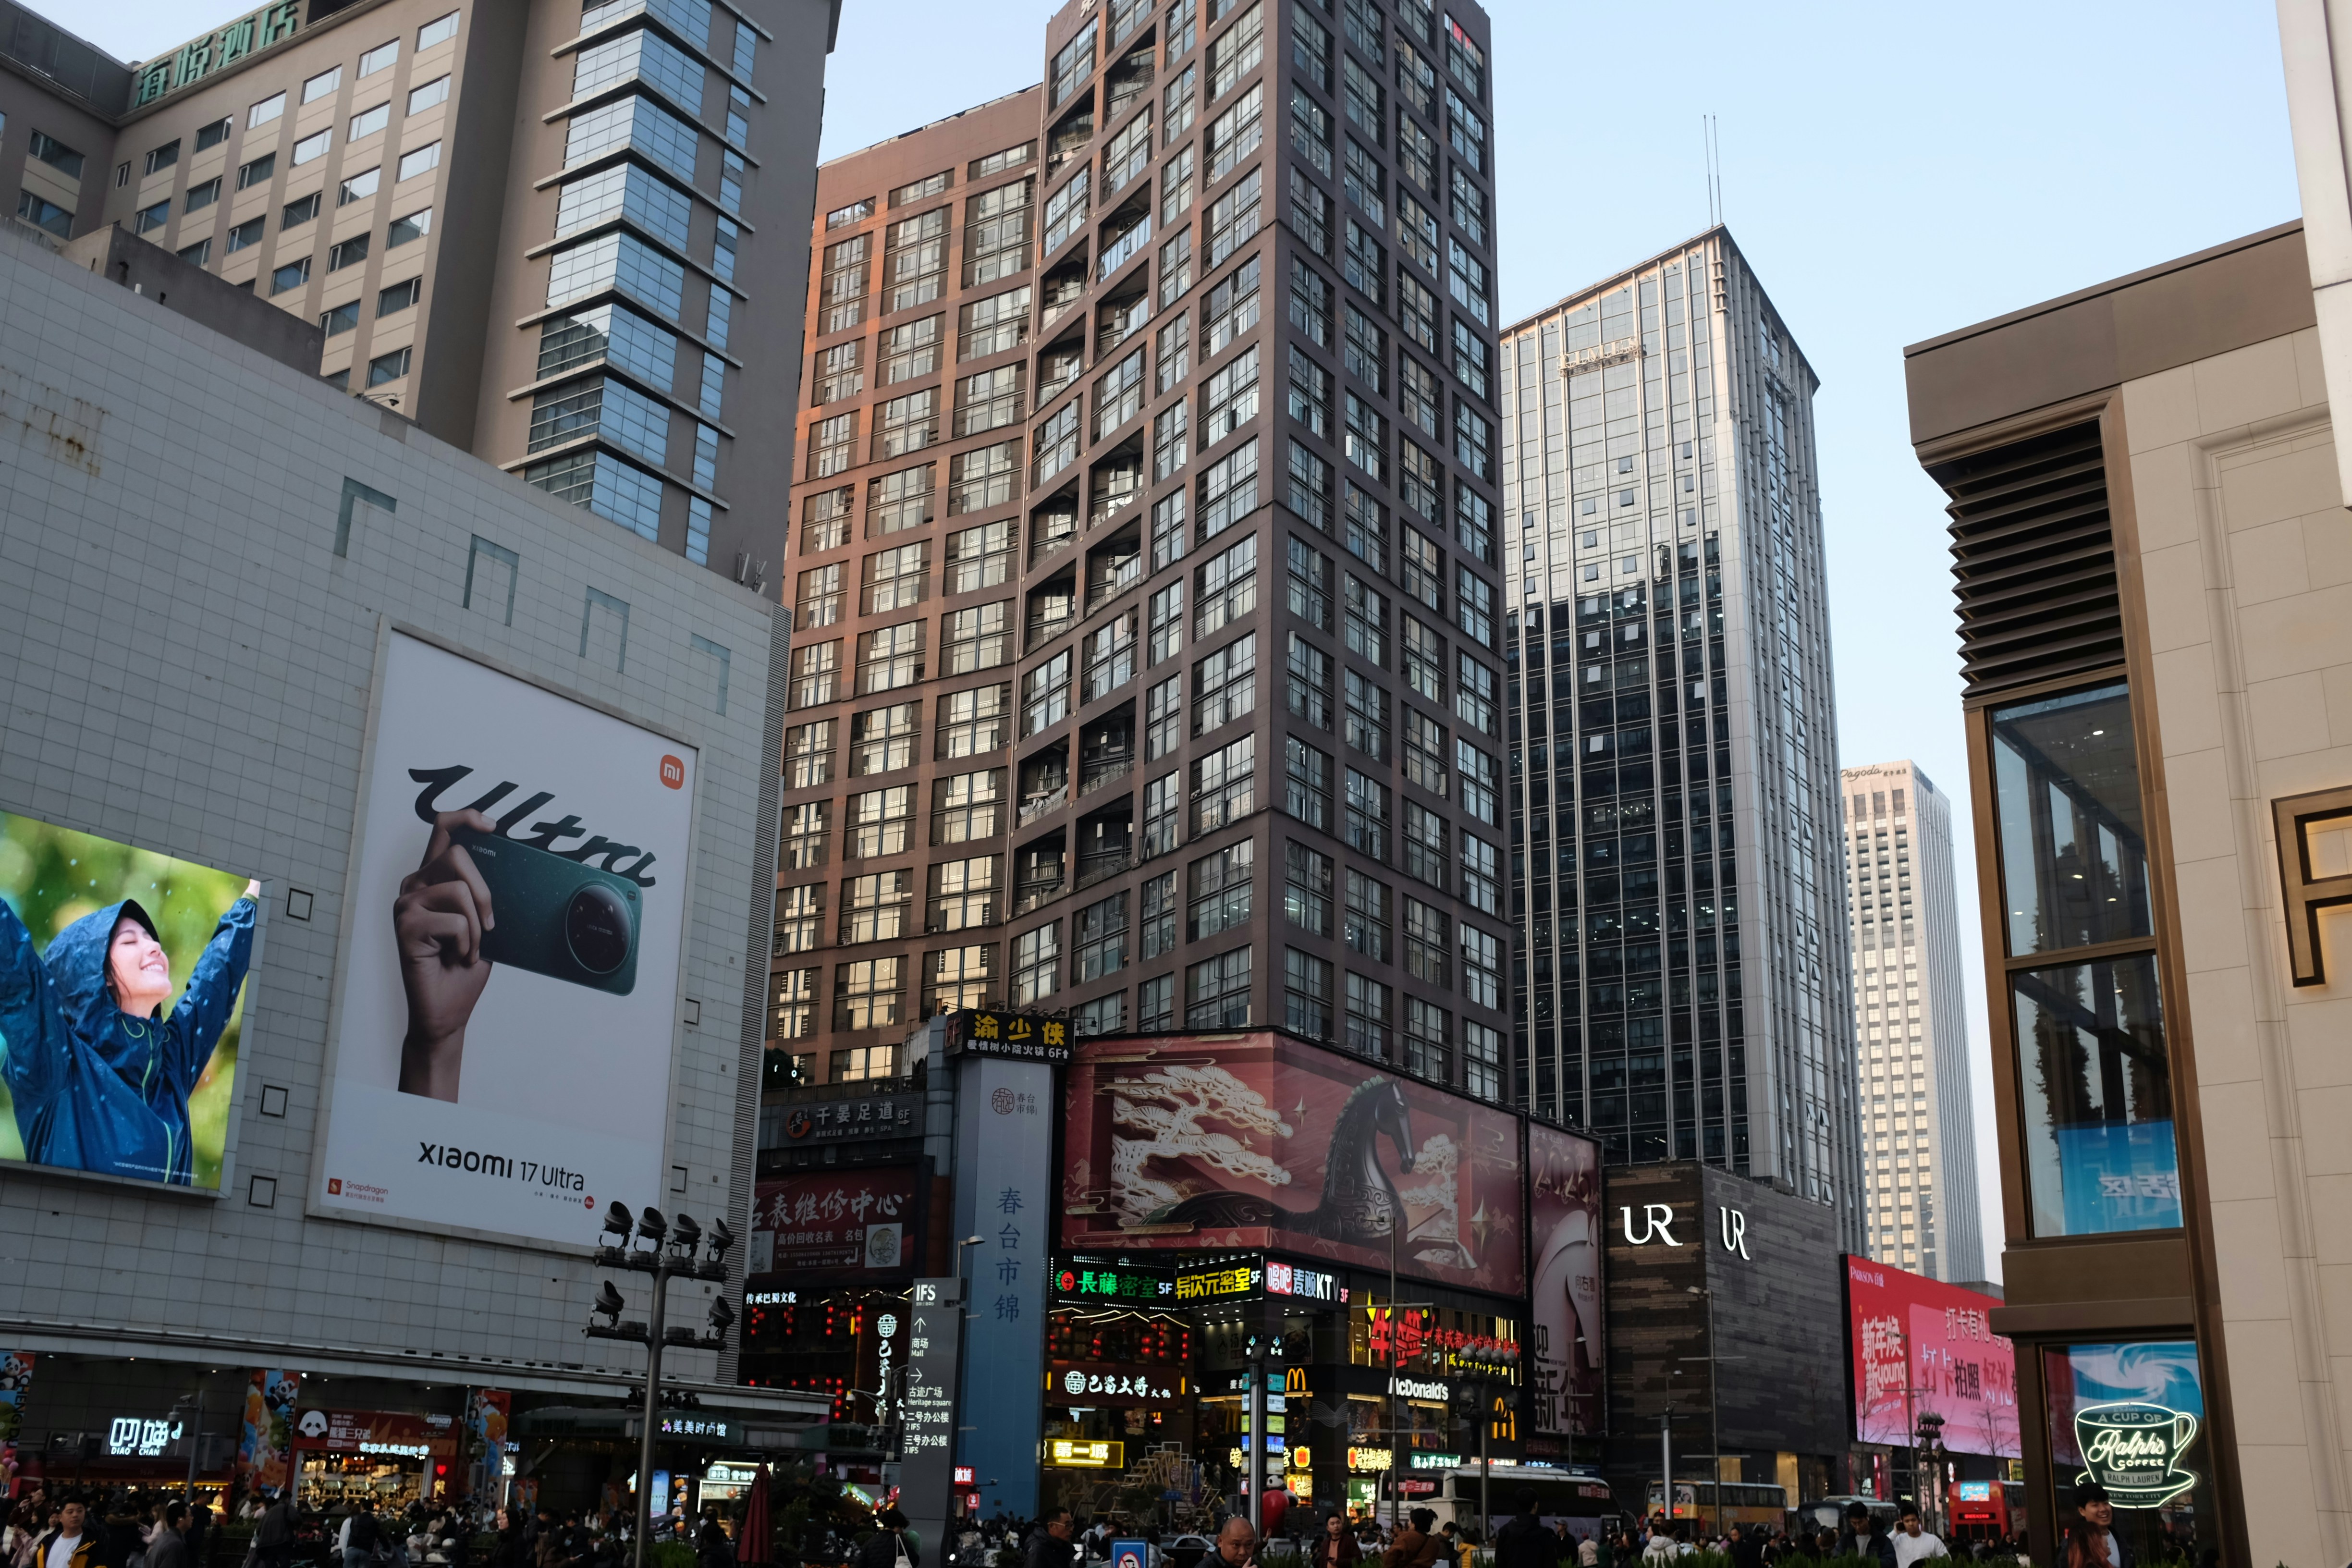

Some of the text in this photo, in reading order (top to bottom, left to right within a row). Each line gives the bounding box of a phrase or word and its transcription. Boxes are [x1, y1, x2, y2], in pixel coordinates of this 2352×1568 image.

[134, 0, 298, 108] 海悦酒店
[408, 765, 657, 888] Ultra
[1048, 1047, 1062, 1058] 6F
[898, 1109, 910, 1120] 6F
[417, 1141, 585, 1191] xiaomi 17 Ultra
[346, 1180, 388, 1196] Snapdragon
[1620, 1204, 1683, 1247] UR
[778, 1228, 864, 1245] 高价回收名表 名包
[1720, 1206, 1751, 1261] UR
[993, 1187, 1025, 1324] 春台市锦
[1158, 1282, 1173, 1295] 5F
[1176, 1267, 1261, 1299] 异次元密室 5F
[746, 1291, 797, 1305] 传承巴蜀文化
[916, 1284, 936, 1301] IFS
[1339, 1288, 1348, 1303] 3F
[911, 1337, 929, 1349] 商场
[909, 1386, 943, 1398] 古迹广场
[907, 1398, 952, 1407] Heritage square
[906, 1411, 950, 1423] 二号办公楼
[2097, 1413, 2163, 1423] A CUP OF
[673, 1419, 727, 1438] 美美时尚馆
[904, 1434, 948, 1447] 三号办公楼
[110, 1447, 160, 1456] DIAO CHAN
[2088, 1429, 2167, 1471] Ralph's
[2107, 1473, 2160, 1483] RALPH LAUREN
